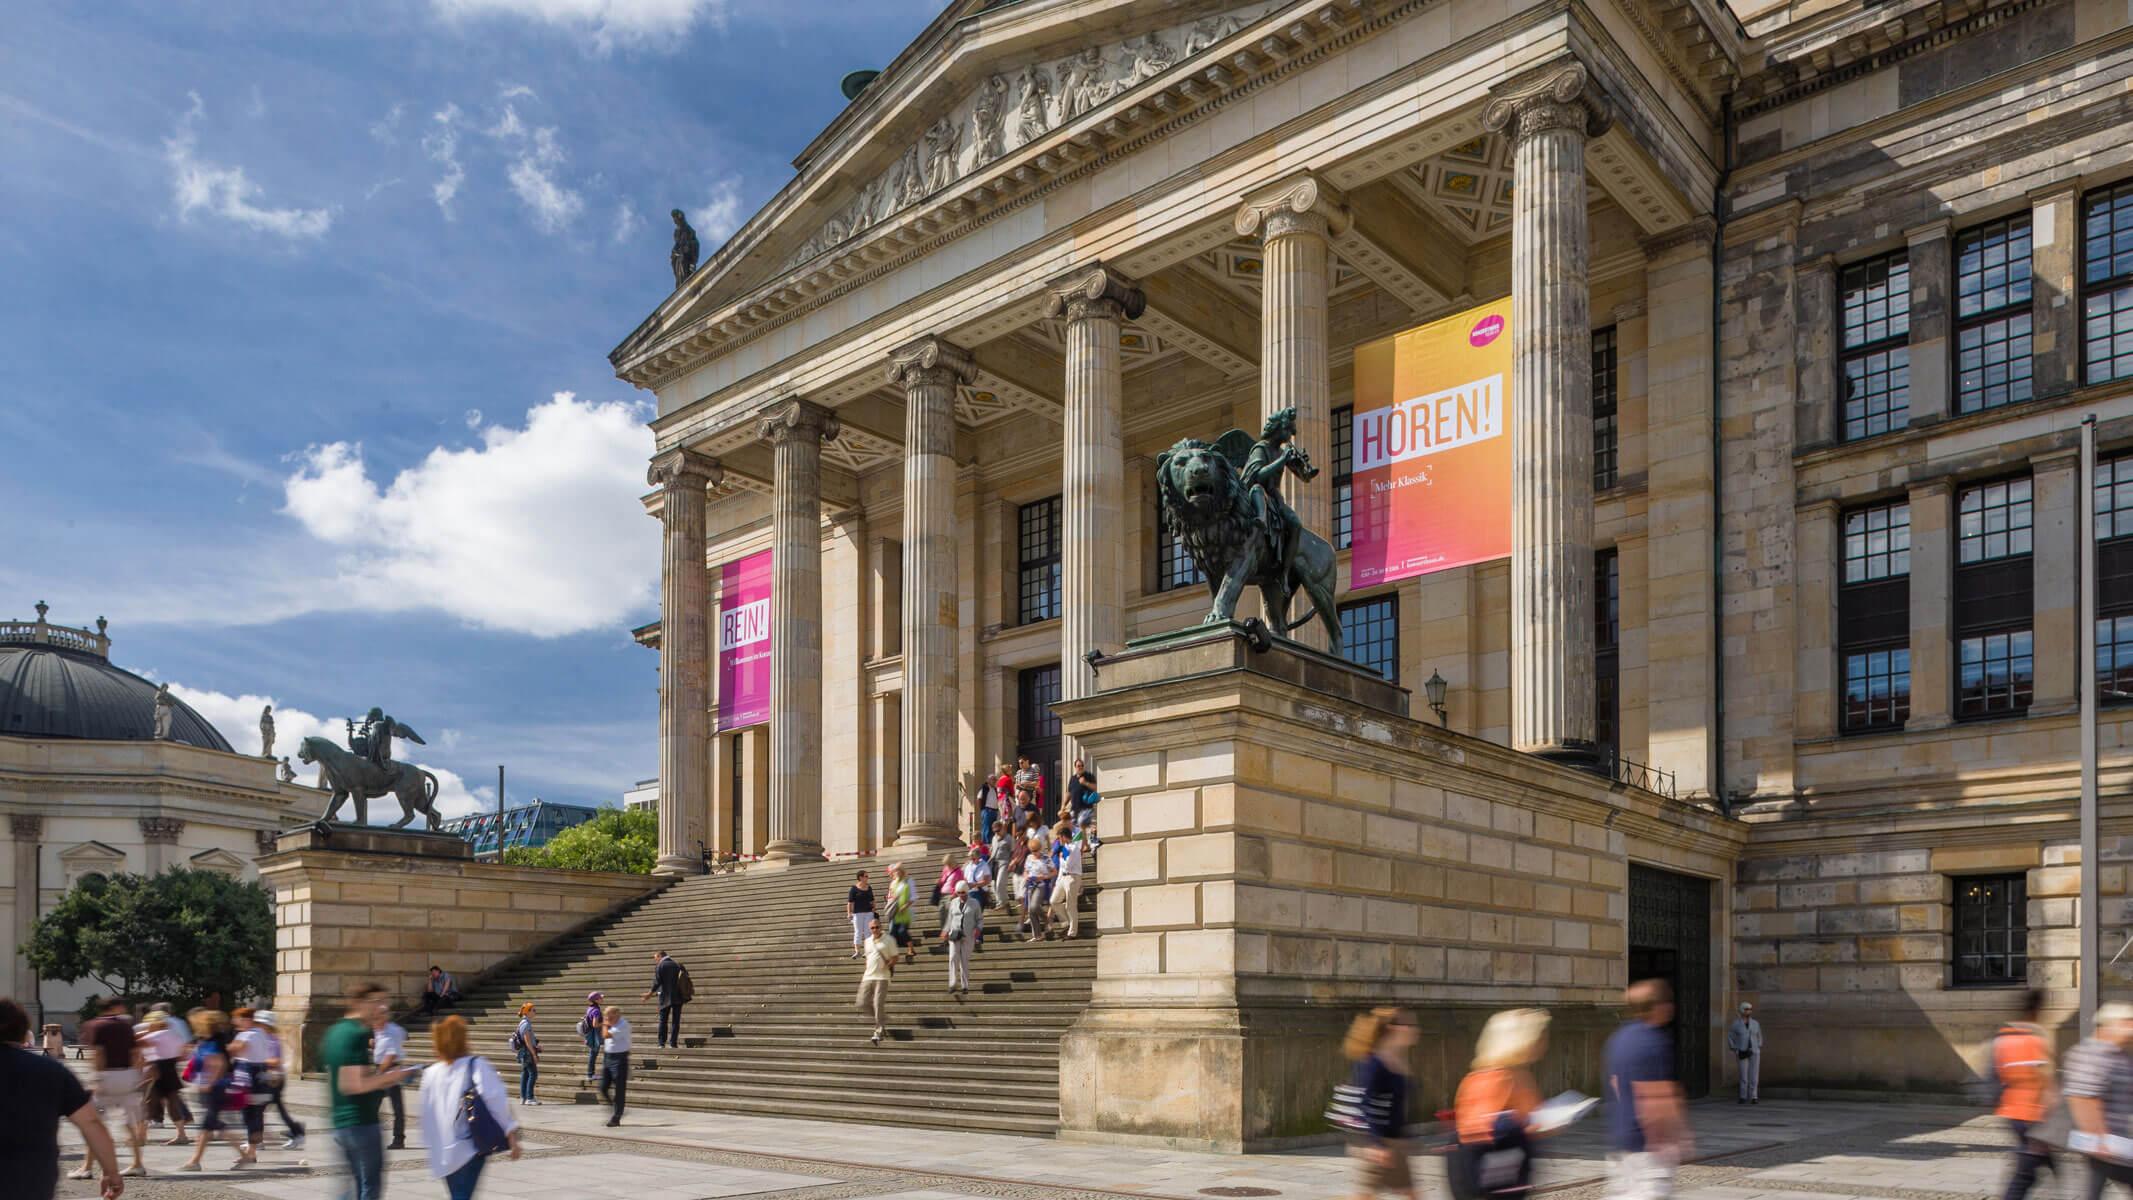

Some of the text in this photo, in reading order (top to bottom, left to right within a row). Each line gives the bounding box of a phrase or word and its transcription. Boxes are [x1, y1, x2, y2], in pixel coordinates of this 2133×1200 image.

[1362, 384, 1490, 464] HÖREN!
[1375, 472, 1428, 493] Mehr Klassik
[725, 604, 765, 646] REIN!
